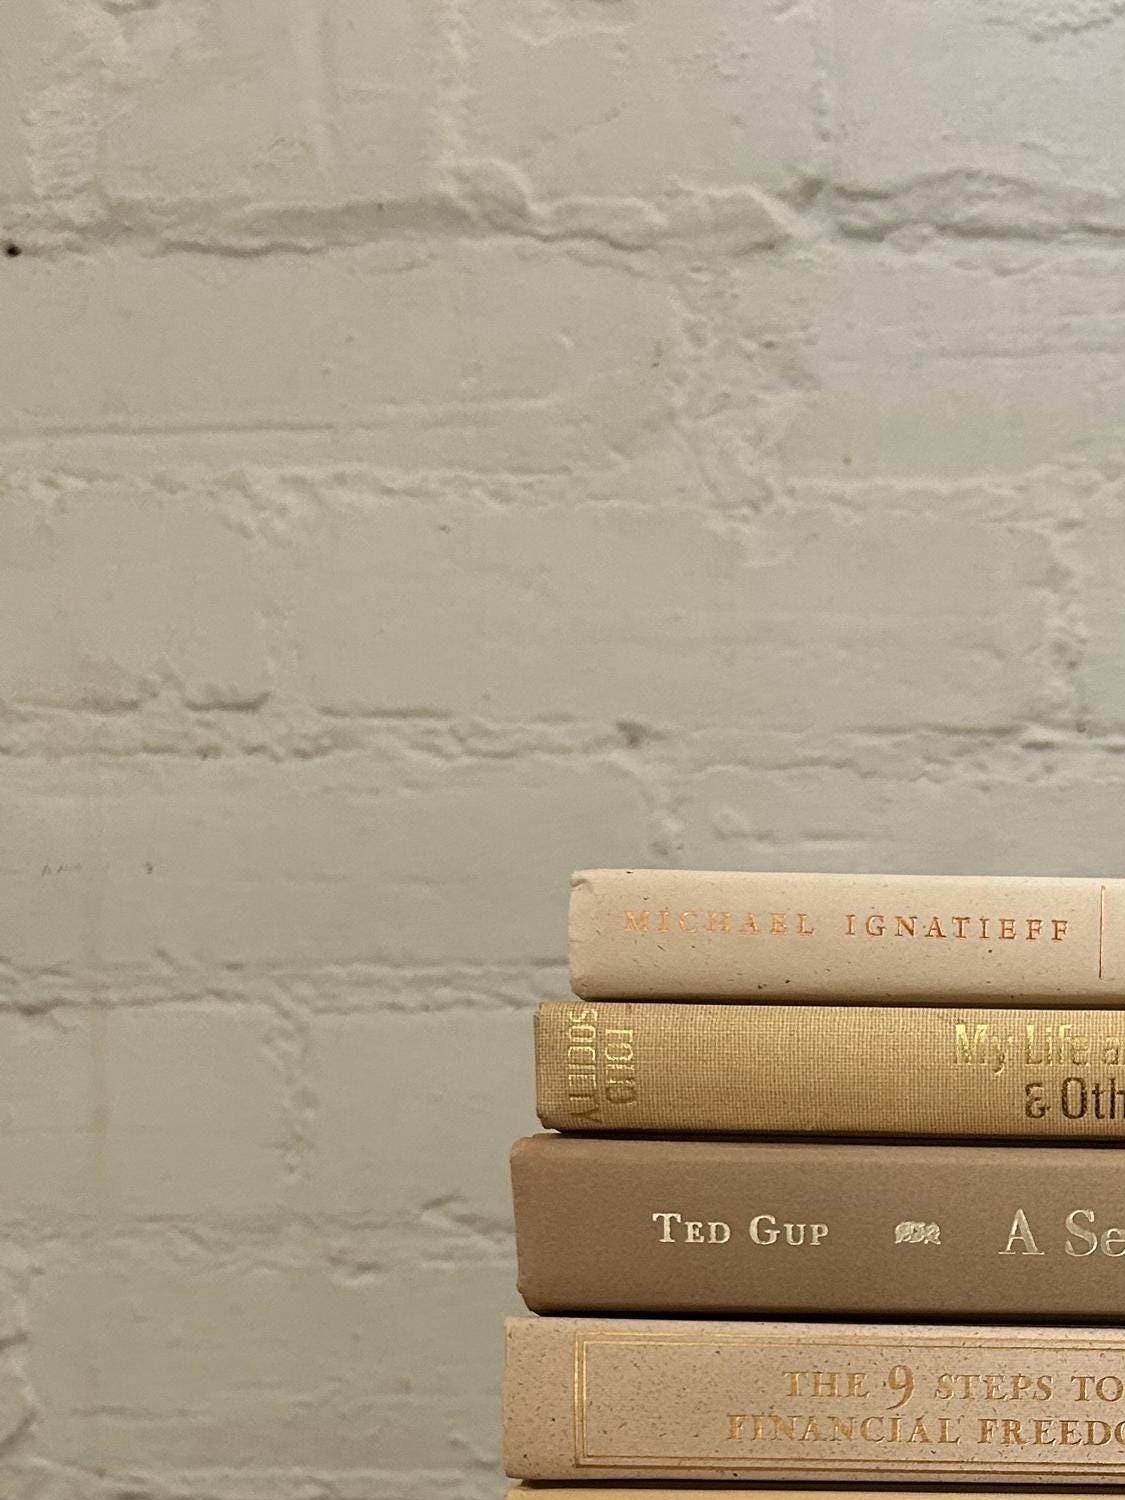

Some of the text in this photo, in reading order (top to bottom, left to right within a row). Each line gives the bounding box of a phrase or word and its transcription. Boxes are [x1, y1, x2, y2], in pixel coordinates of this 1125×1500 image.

[624, 910, 1070, 942] MICHAEL IGNATIEFF
[567, 1008, 602, 1123] SOCIETY
[953, 1024, 1006, 1073] My
[1025, 1024, 1088, 1065] Life
[1026, 1083, 1051, 1119] &
[998, 1209, 1044, 1256] A
[784, 1365, 1124, 1410] THE 9 STEPS TO
[726, 1414, 959, 1446] FINANCIAL
